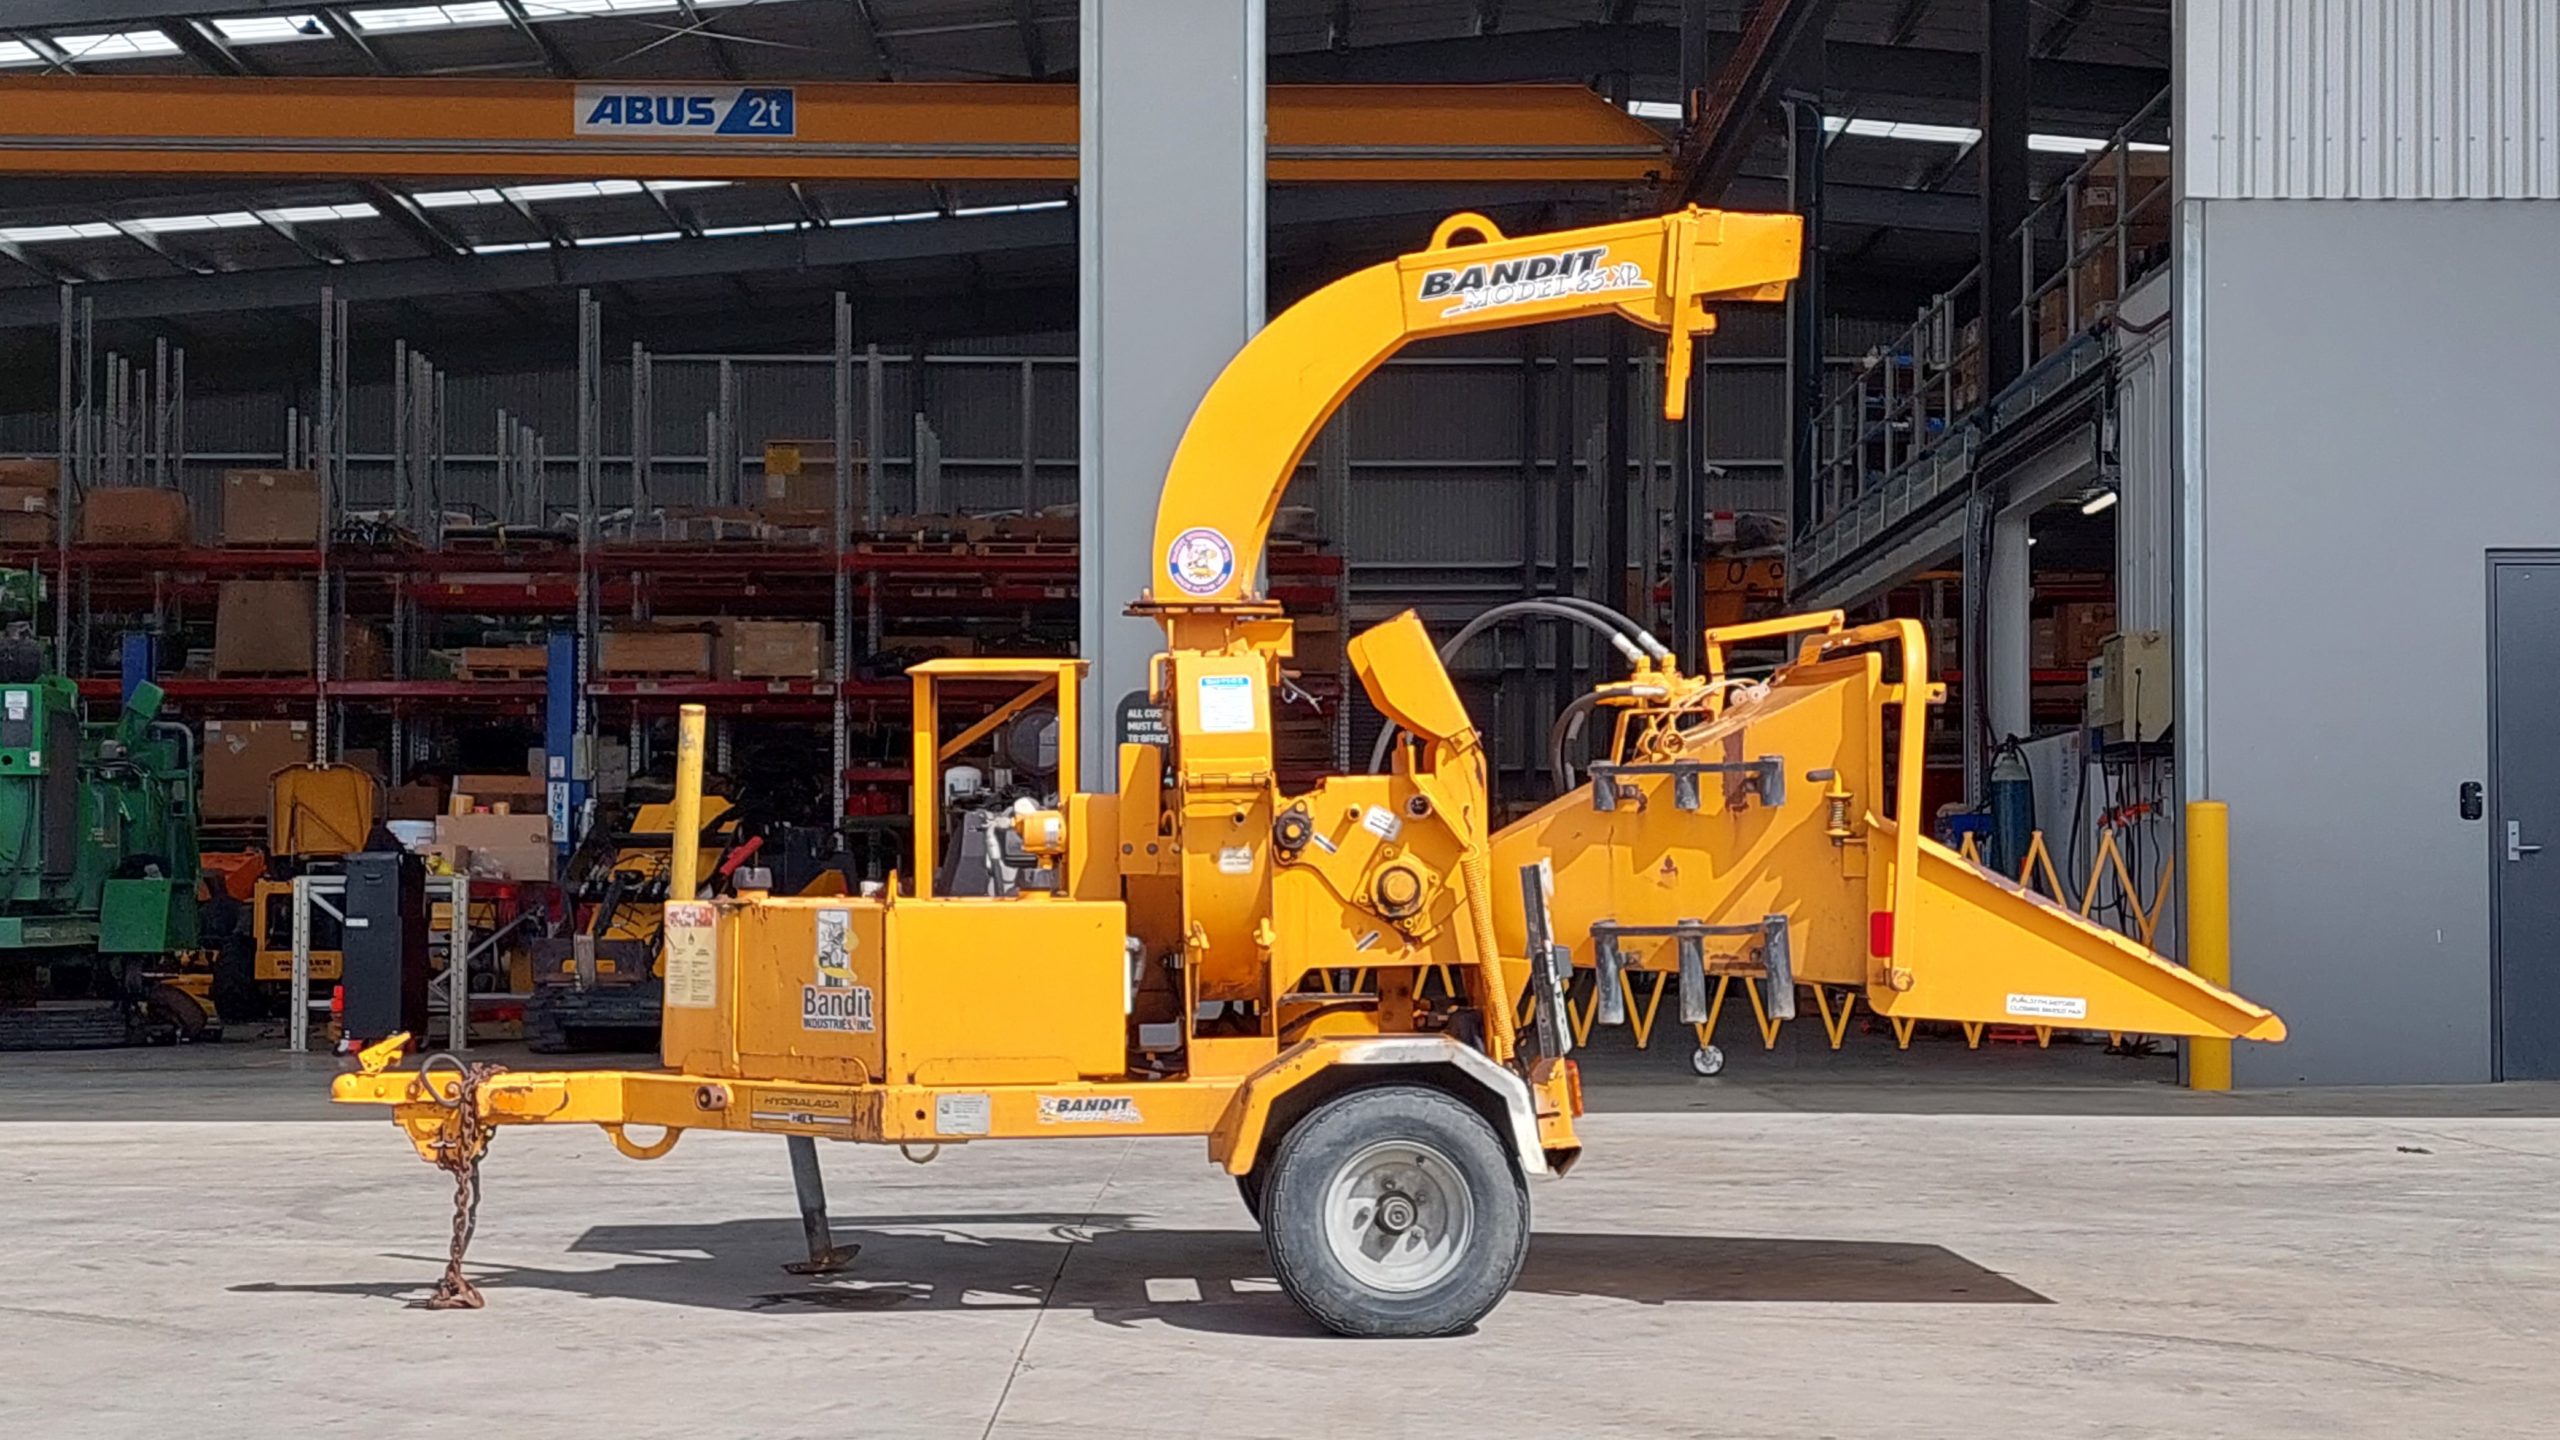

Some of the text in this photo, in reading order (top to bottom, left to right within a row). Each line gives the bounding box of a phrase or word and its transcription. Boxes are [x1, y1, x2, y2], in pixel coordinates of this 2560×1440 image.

[586, 96, 782, 127] ABUS 2t
[1420, 248, 1606, 299] BANDIT
[1127, 708, 1143, 719] ALL
[1127, 721, 1151, 731] MUST
[1127, 733, 1169, 744] TO OFFICE
[804, 986, 871, 1017] Bandit
[1056, 1098, 1131, 1112] BANDIT
